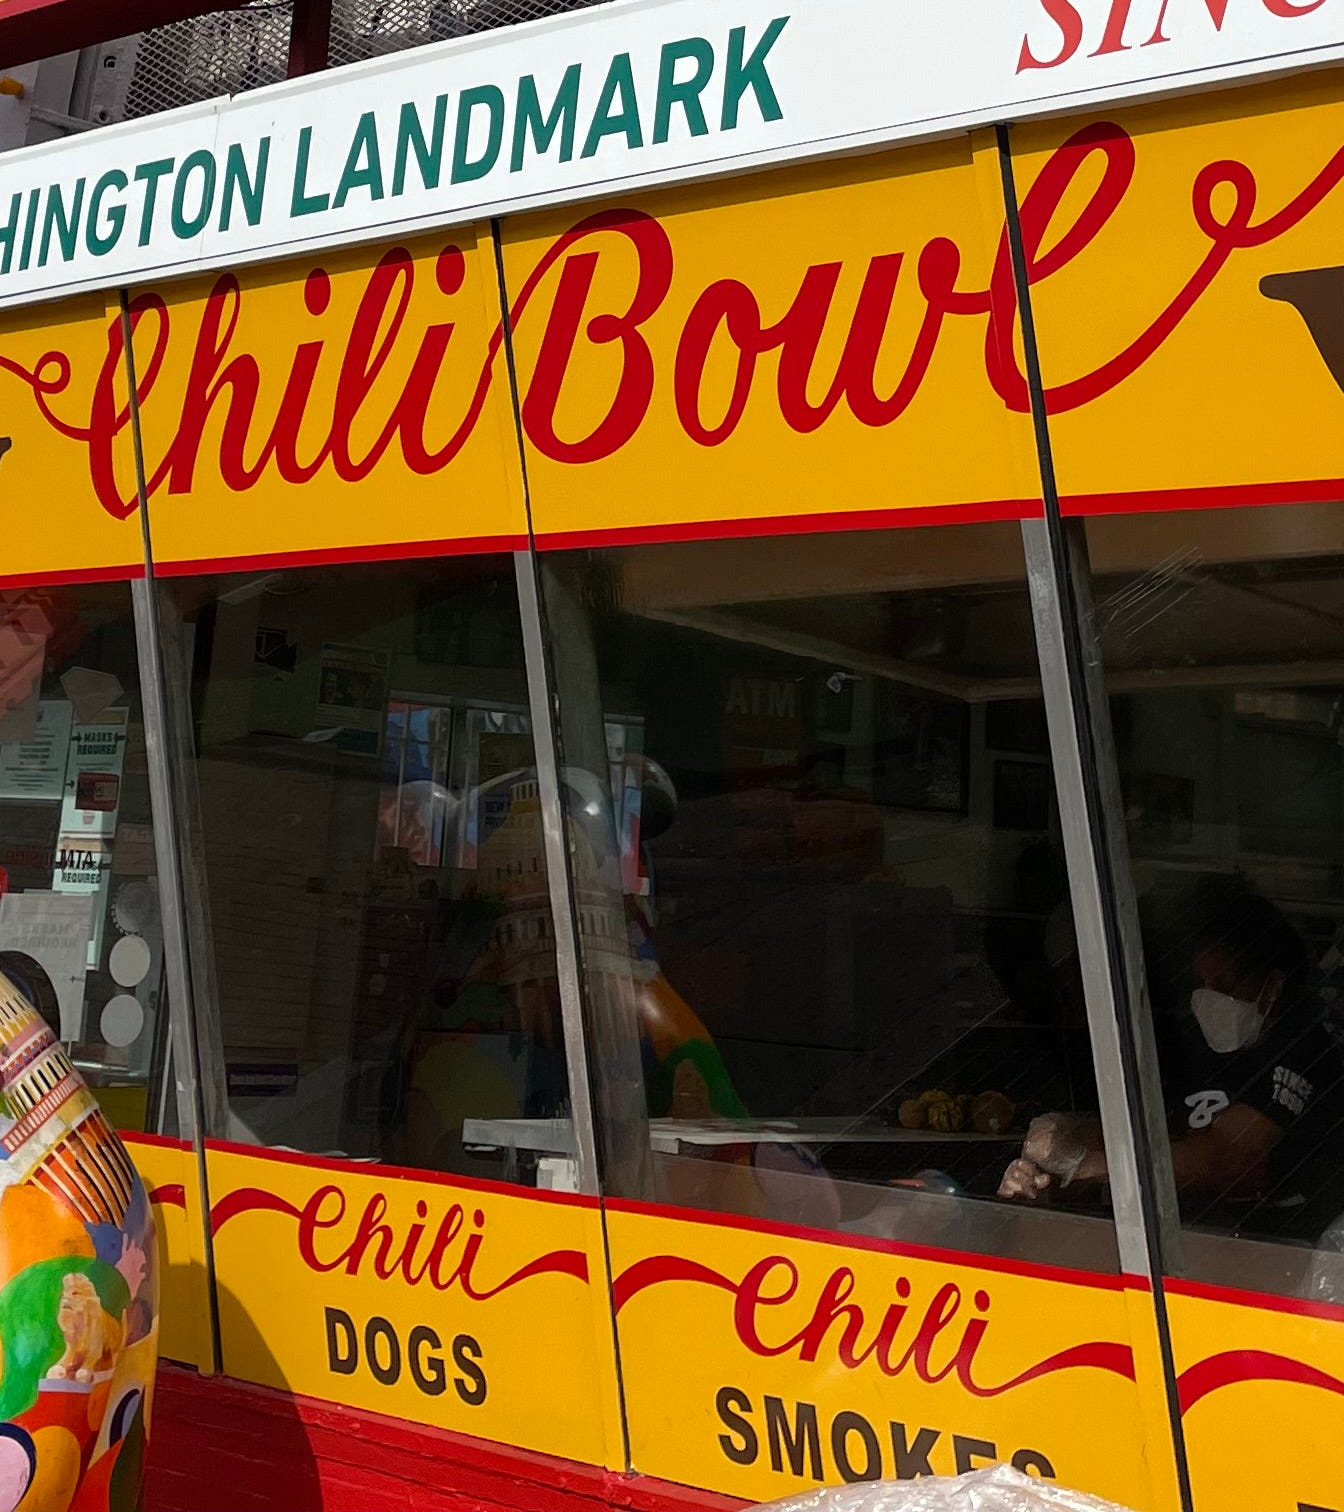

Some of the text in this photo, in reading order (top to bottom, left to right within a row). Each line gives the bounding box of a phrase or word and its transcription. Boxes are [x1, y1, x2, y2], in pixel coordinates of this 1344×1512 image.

[288, 15, 791, 219] LANDMARK
[88, 122, 1136, 520] Chili Bowl
[77, 744, 116, 755] REQUIRED
[84, 732, 112, 743] MASKS
[61, 873, 102, 884] REQUIRED
[298, 1184, 491, 1300] Chili
[326, 1306, 487, 1408] DOGS
[734, 1254, 996, 1398] Chili
